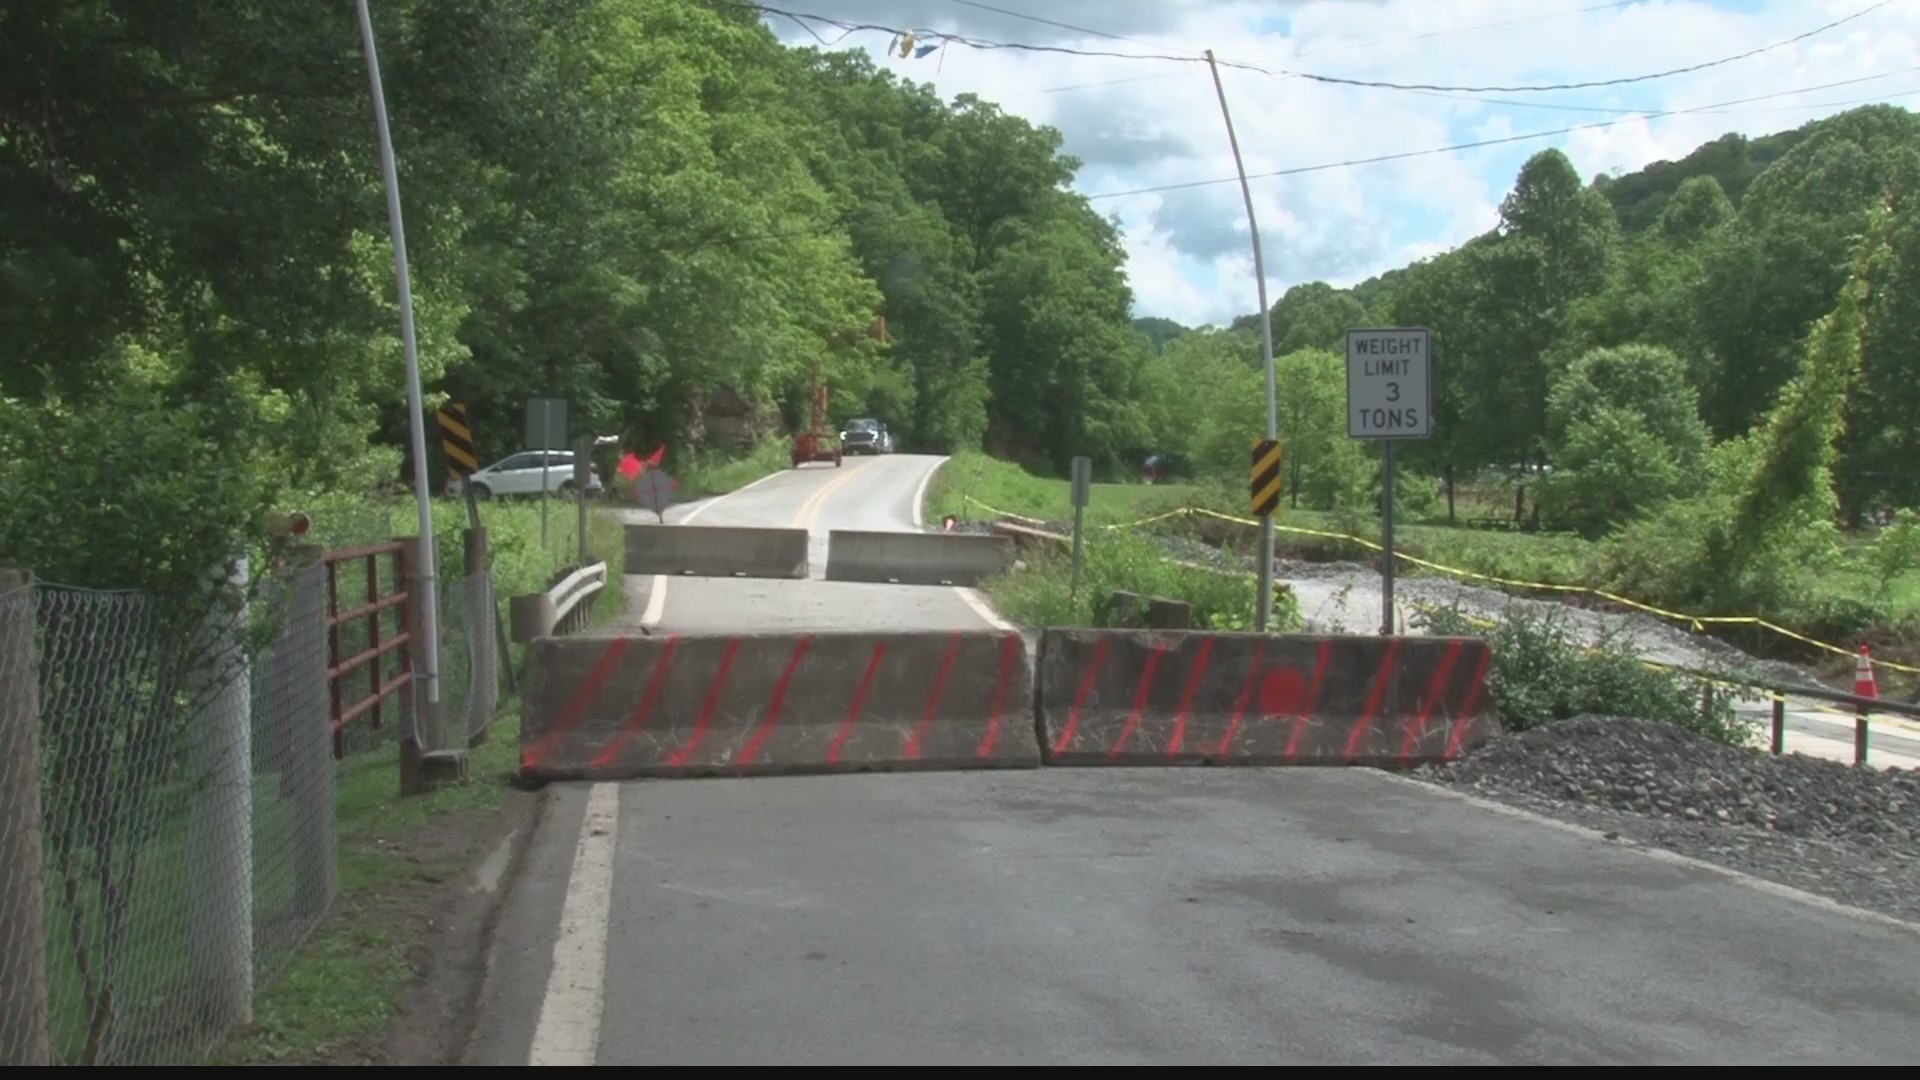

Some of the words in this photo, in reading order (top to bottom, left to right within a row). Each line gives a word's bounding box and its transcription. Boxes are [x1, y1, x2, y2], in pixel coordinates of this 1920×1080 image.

[1355, 338, 1422, 355] WEIGHT
[1364, 359, 1410, 376] LIMIT
[1385, 382, 1400, 402] 3
[1359, 408, 1418, 429] TONS
